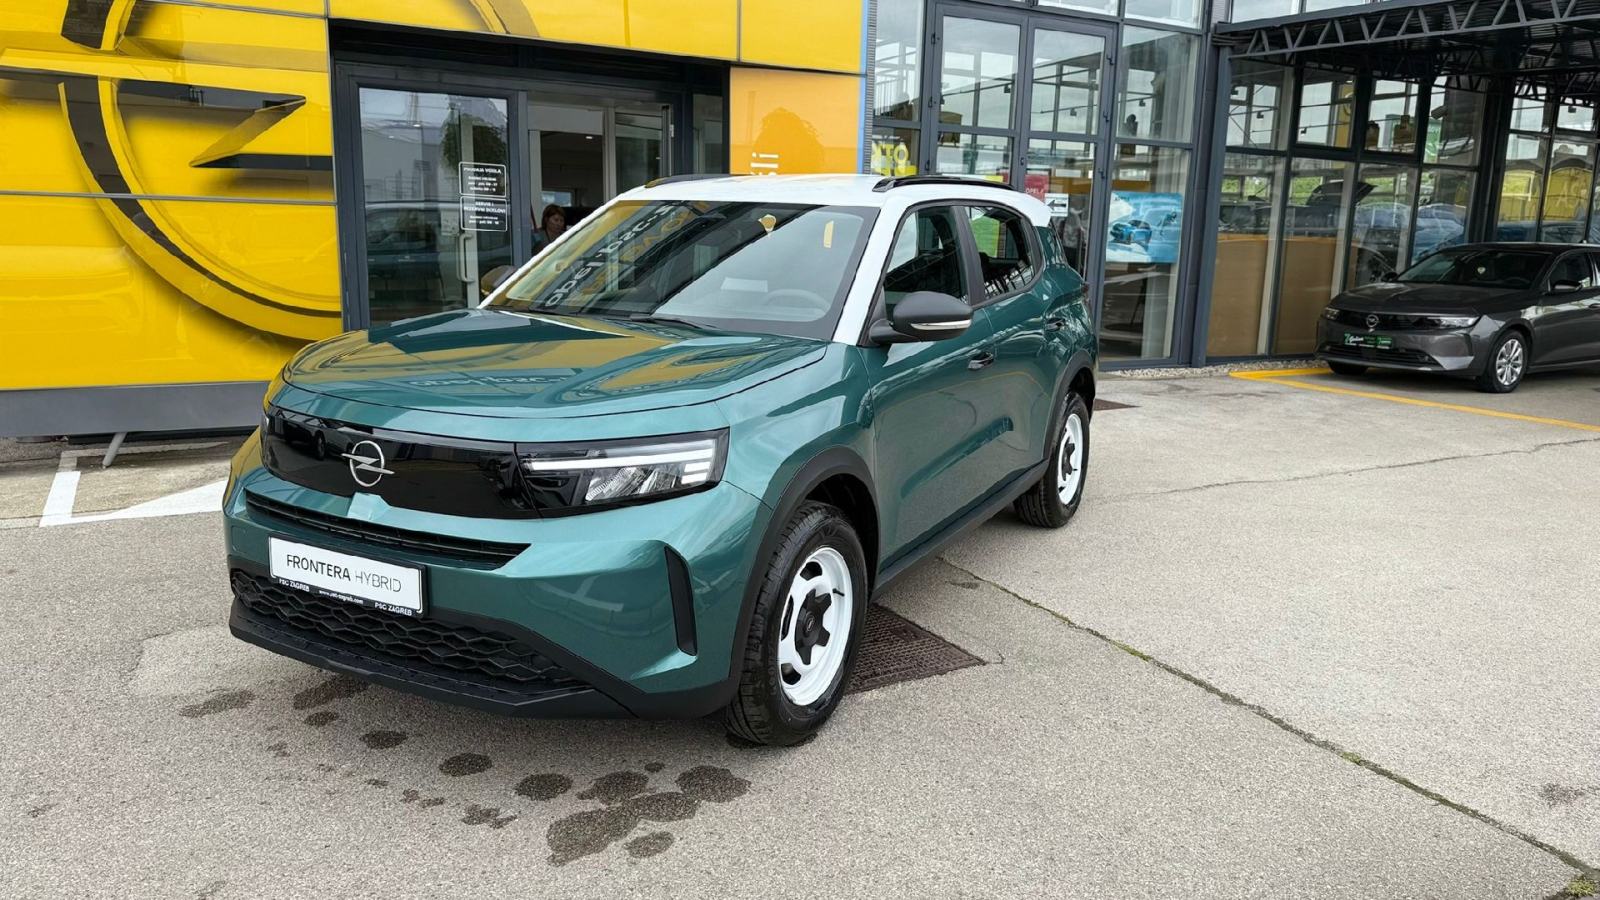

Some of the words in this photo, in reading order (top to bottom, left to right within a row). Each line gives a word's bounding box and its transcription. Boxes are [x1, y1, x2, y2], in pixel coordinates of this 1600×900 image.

[286, 554, 351, 581] FRONTERA
[355, 570, 402, 592] HYBRID
[278, 578, 289, 587] PSC
[290, 580, 310, 592] ZAGREB
[374, 602, 387, 612] PSC
[388, 604, 412, 616] ZAGREB
